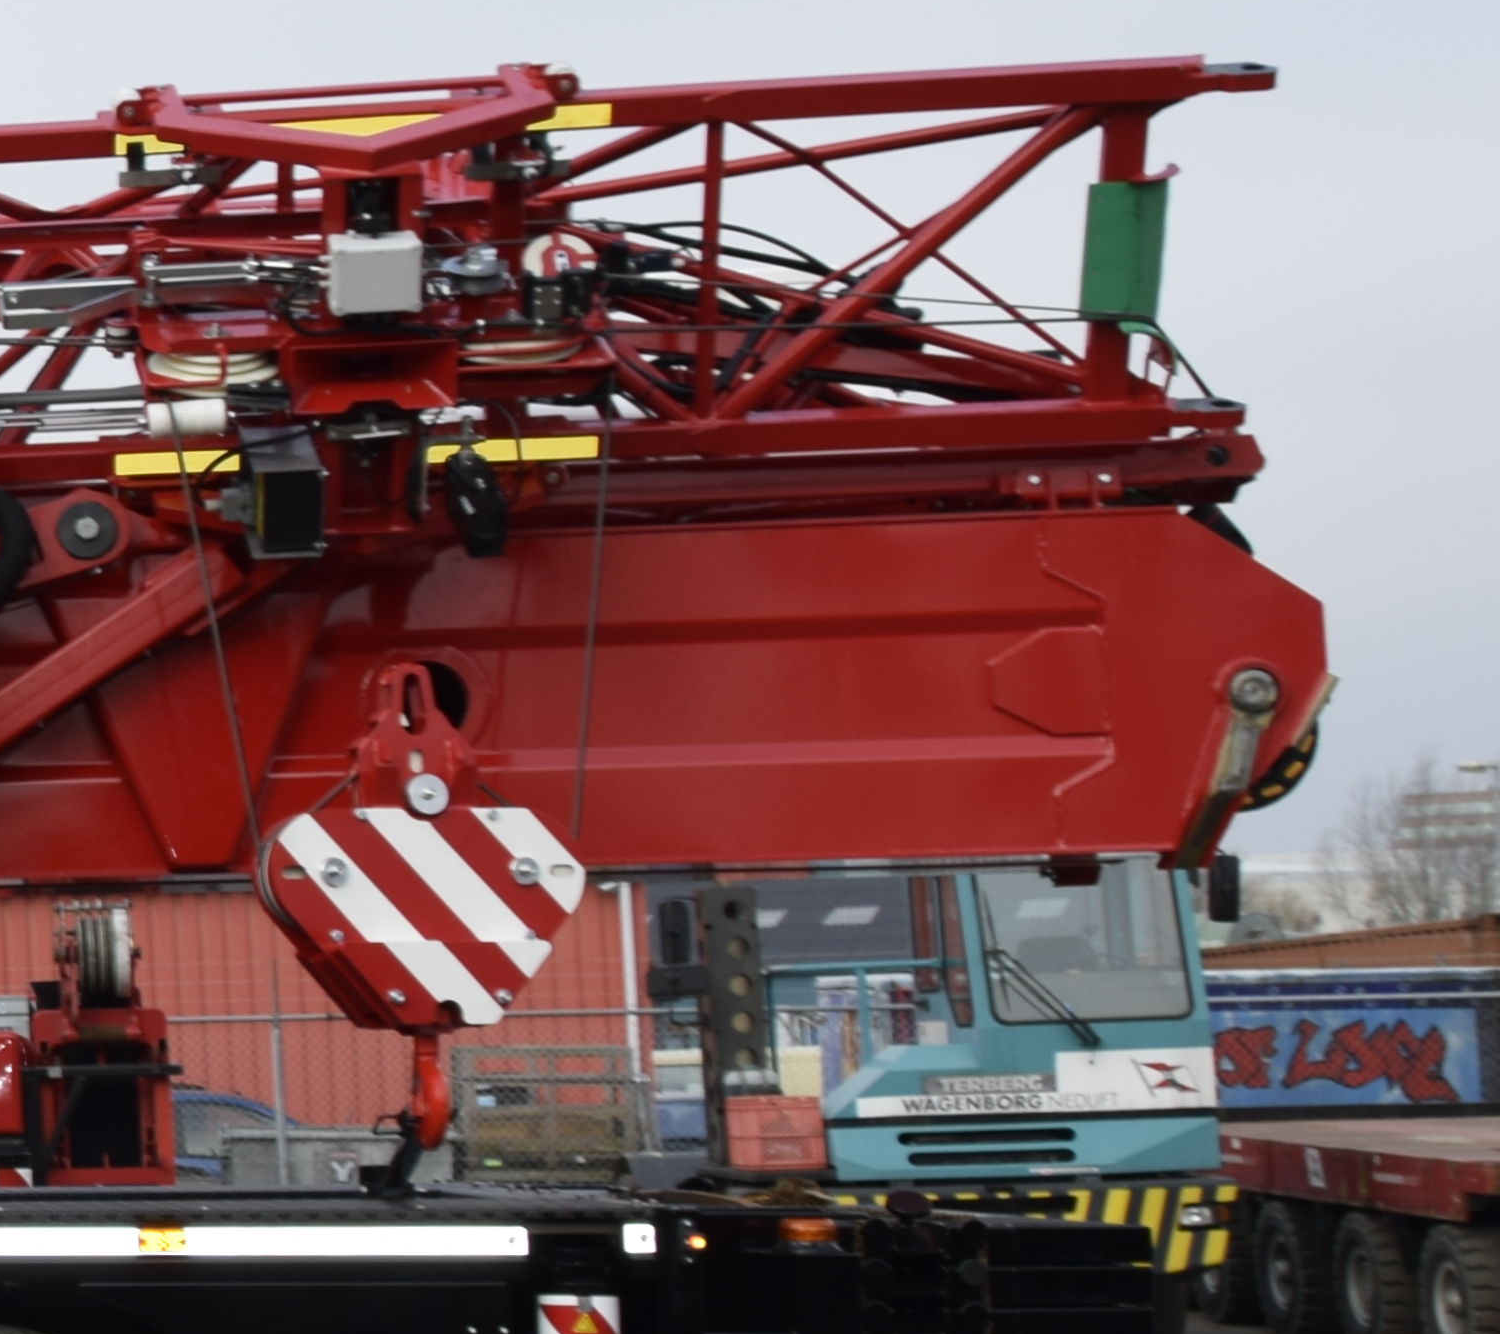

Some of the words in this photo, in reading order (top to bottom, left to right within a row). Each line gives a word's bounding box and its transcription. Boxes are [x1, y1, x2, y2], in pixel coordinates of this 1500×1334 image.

[938, 1074, 1044, 1093] TERBERG
[902, 1091, 1043, 1113] WAGENBORG
[1050, 1091, 1118, 1109] NEDLIFT
